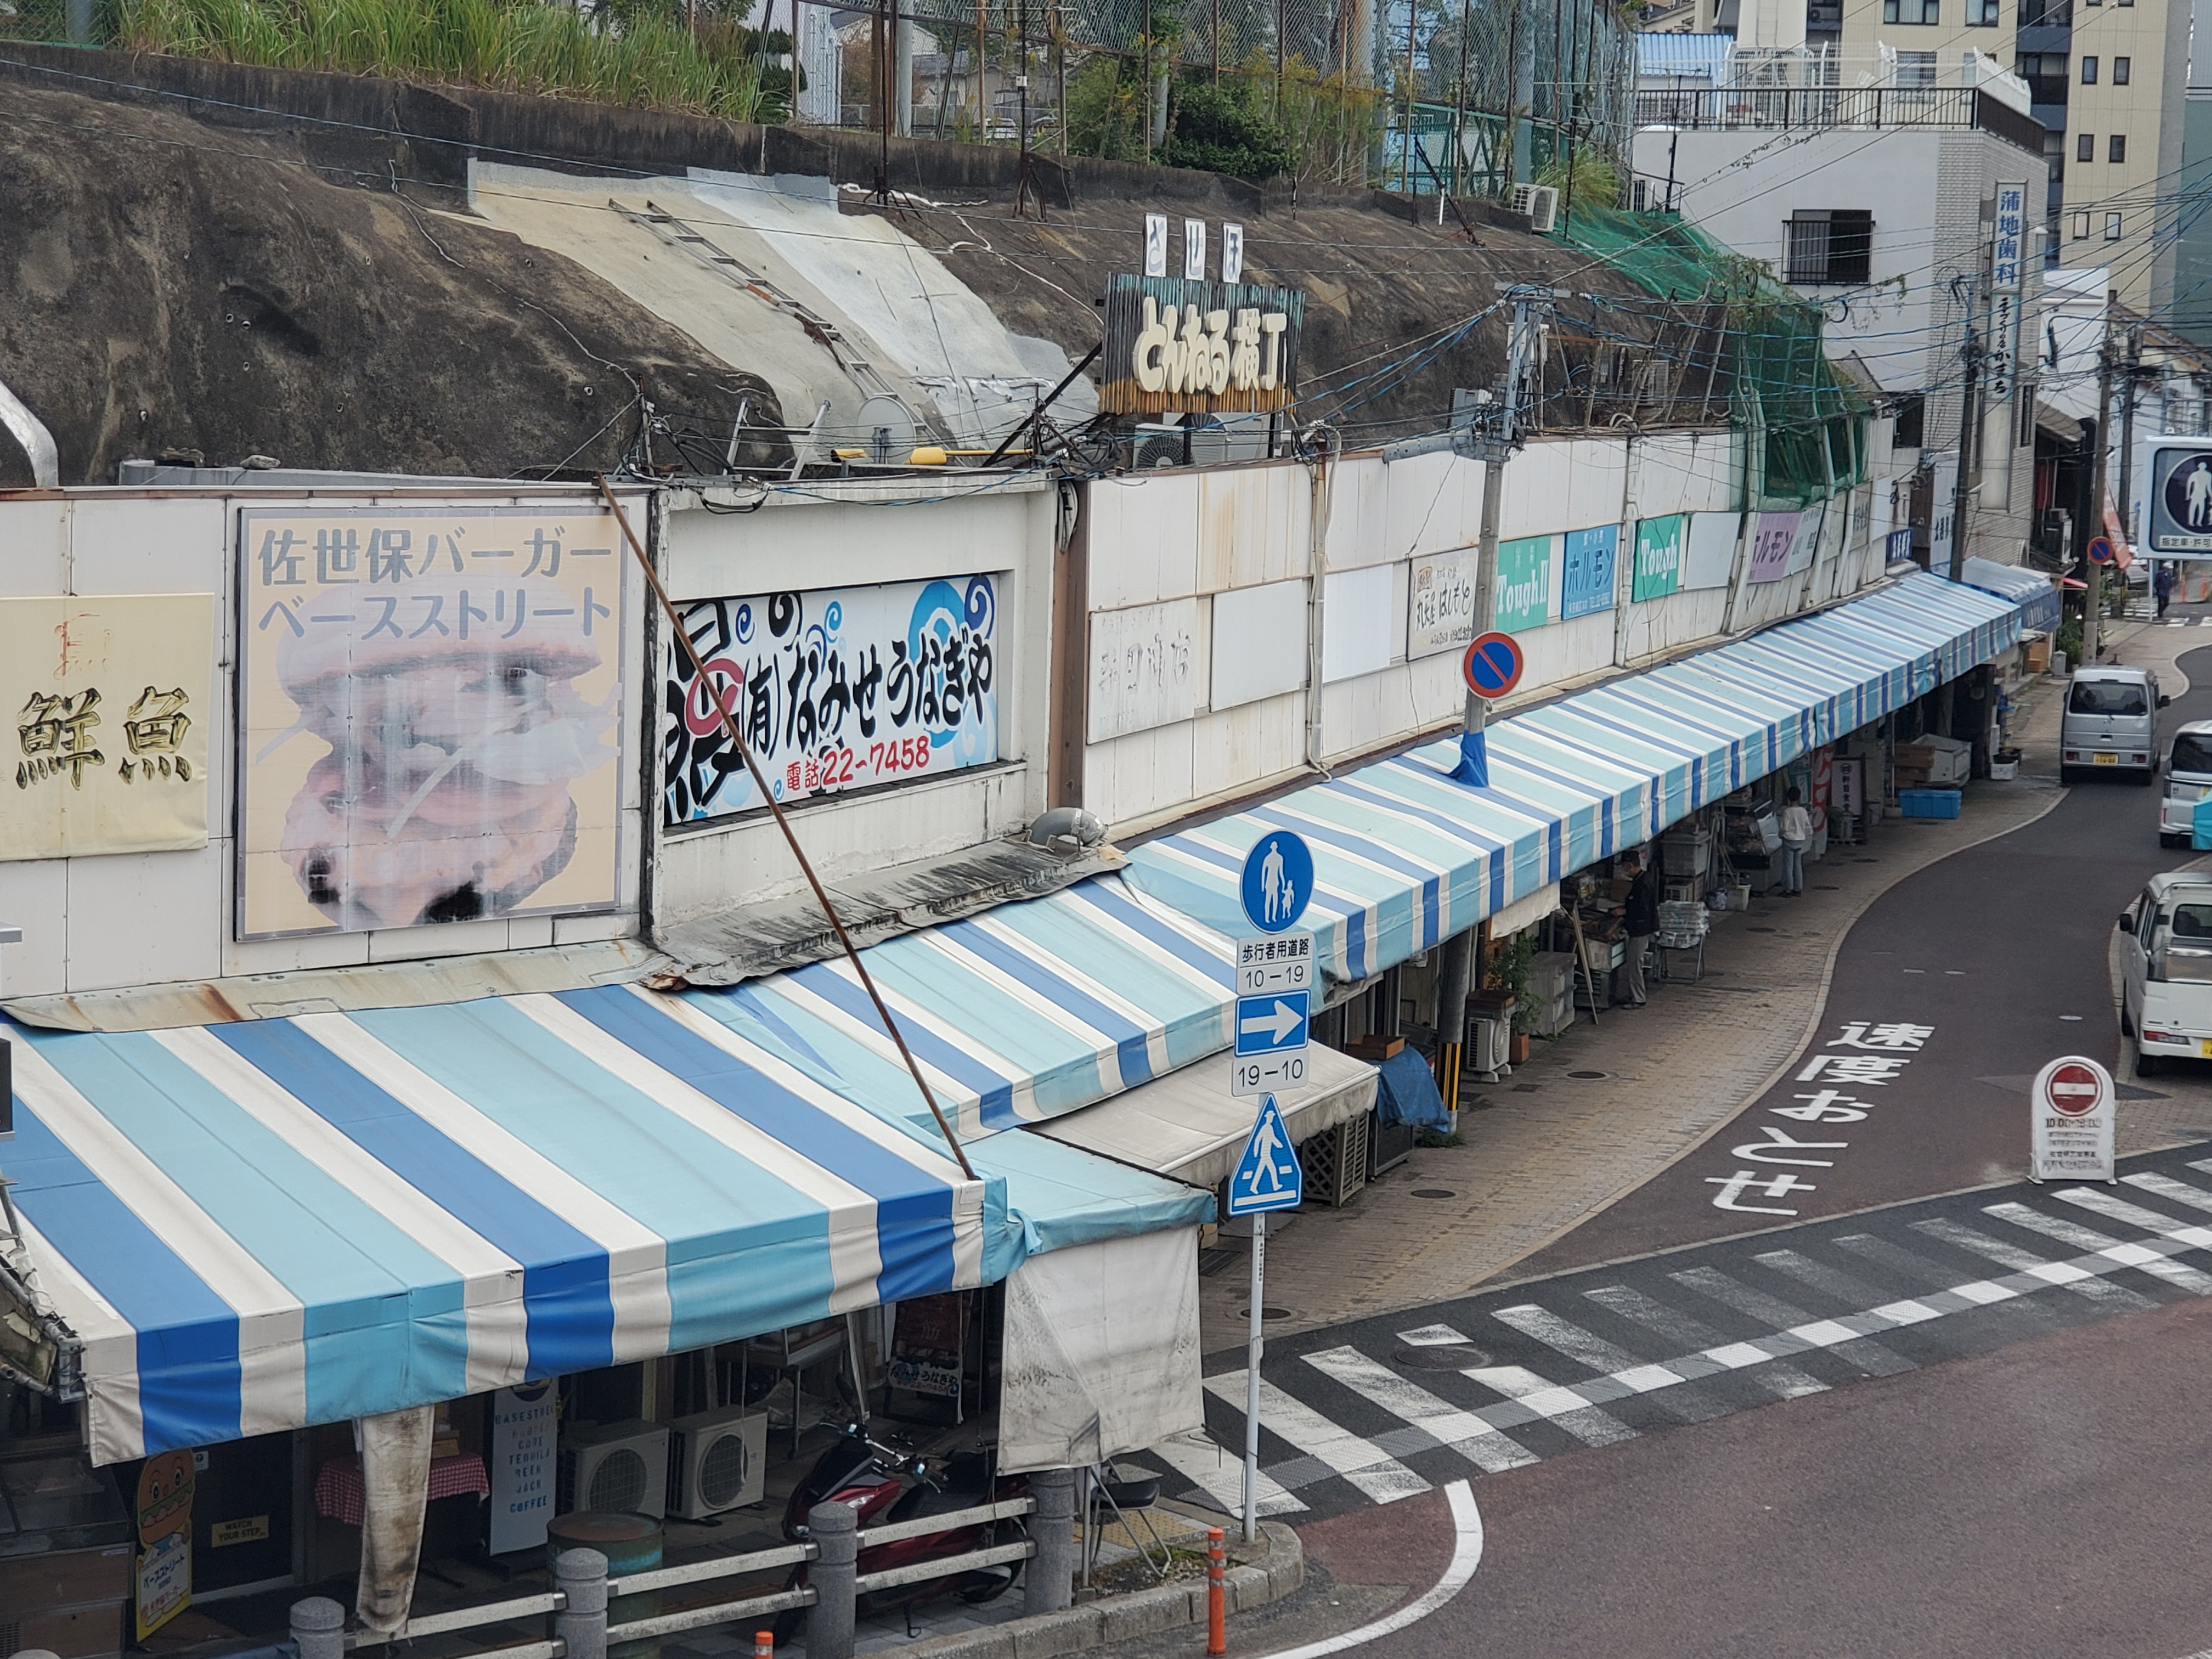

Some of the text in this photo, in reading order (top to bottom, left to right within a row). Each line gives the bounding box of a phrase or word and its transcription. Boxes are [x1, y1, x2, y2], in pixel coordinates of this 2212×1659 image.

[1995, 190, 2022, 285] 蒲地歯科
[1133, 297, 1286, 395] とんねる横丁
[258, 527, 612, 586] 佐世保バーガー
[1568, 548, 1615, 595] ホルモン
[1640, 533, 1677, 580] Tough
[258, 586, 612, 641] ベースストリート
[15, 686, 193, 791] 鮮魚
[1242, 938, 1309, 963] 歩行者用道路
[1246, 965, 1304, 989] 10-19
[1238, 1059, 1303, 1087] 19-10
[1704, 1021, 1936, 1216] 速度おとせ
[225, 1519, 252, 1531] WATCH
[510, 1495, 547, 1513] COFFEE
[219, 1527, 261, 1542] YOUR STEP
